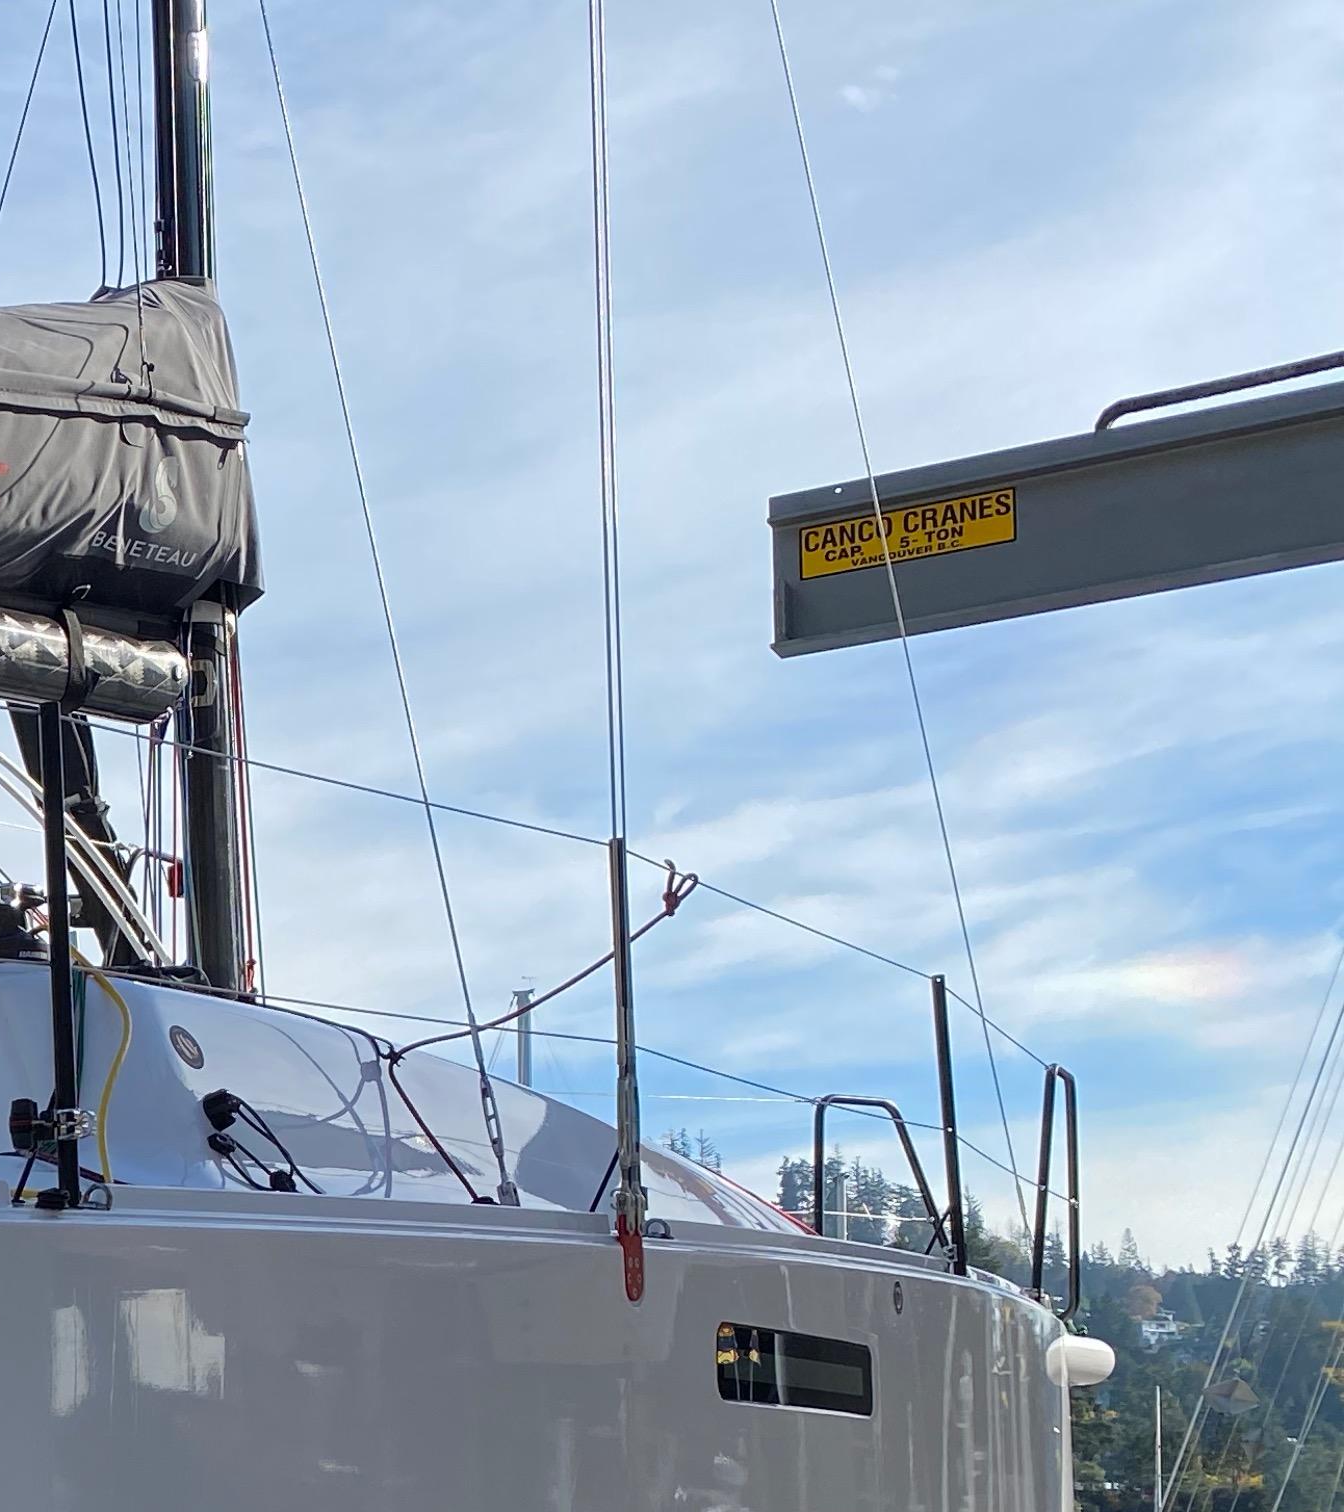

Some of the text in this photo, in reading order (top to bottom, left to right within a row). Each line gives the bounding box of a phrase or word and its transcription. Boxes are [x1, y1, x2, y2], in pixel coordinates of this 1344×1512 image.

[804, 493, 1011, 552] CANCO CRANES
[924, 525, 964, 543] TON
[91, 530, 198, 568] BENETEAU
[851, 544, 933, 567] VANCOUVER
